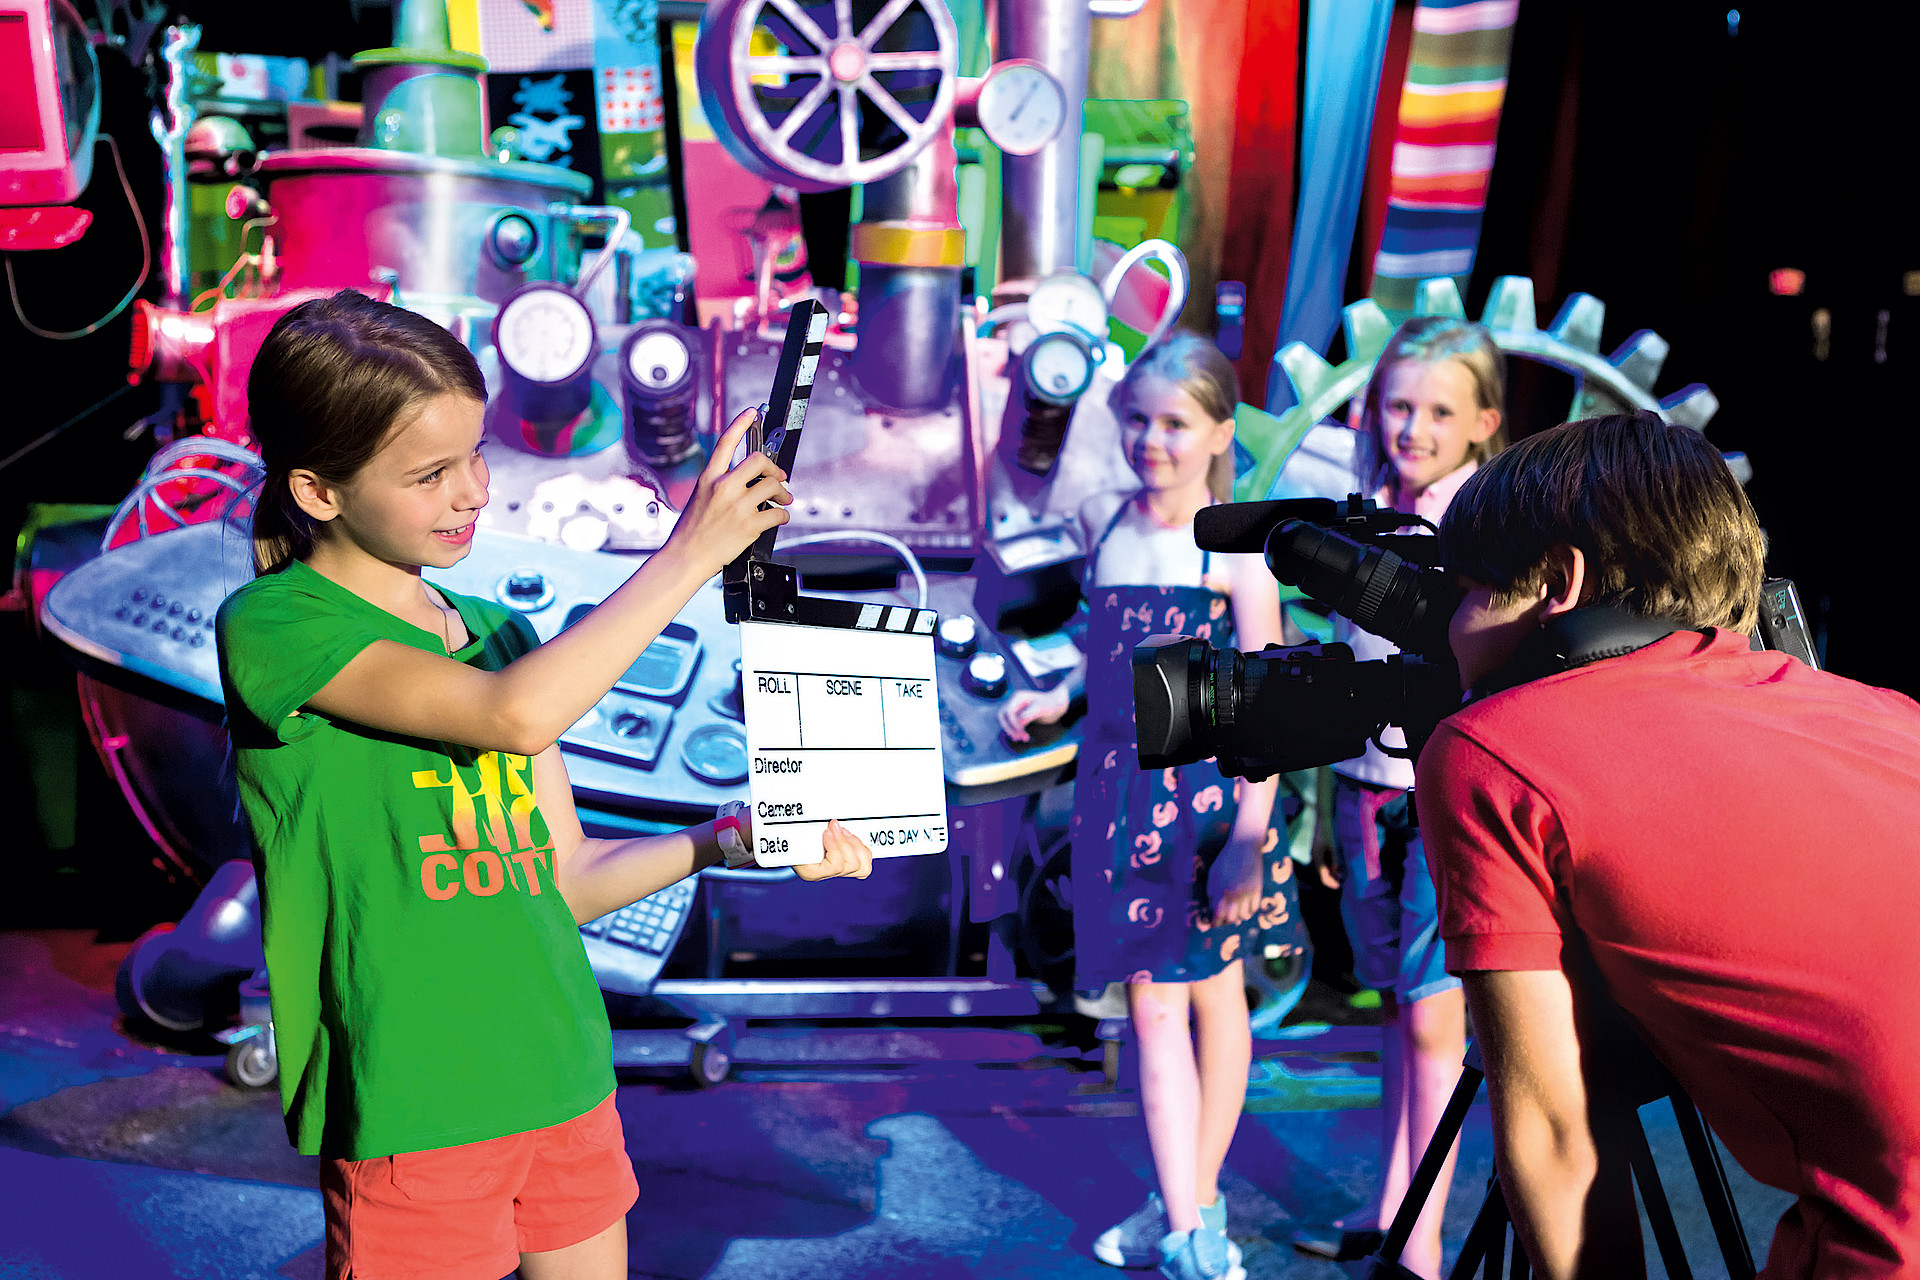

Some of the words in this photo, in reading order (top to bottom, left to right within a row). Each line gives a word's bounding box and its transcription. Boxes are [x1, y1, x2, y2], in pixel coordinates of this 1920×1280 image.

[758, 676, 792, 694] ROLL
[826, 679, 863, 696] SCENE
[895, 682, 923, 698] TAKE
[754, 757, 803, 774] Director
[757, 801, 803, 818] Camera
[869, 829, 895, 846] MOS
[898, 829, 919, 845] DAY
[923, 826, 946, 843] NTE
[760, 837, 789, 854] Date
